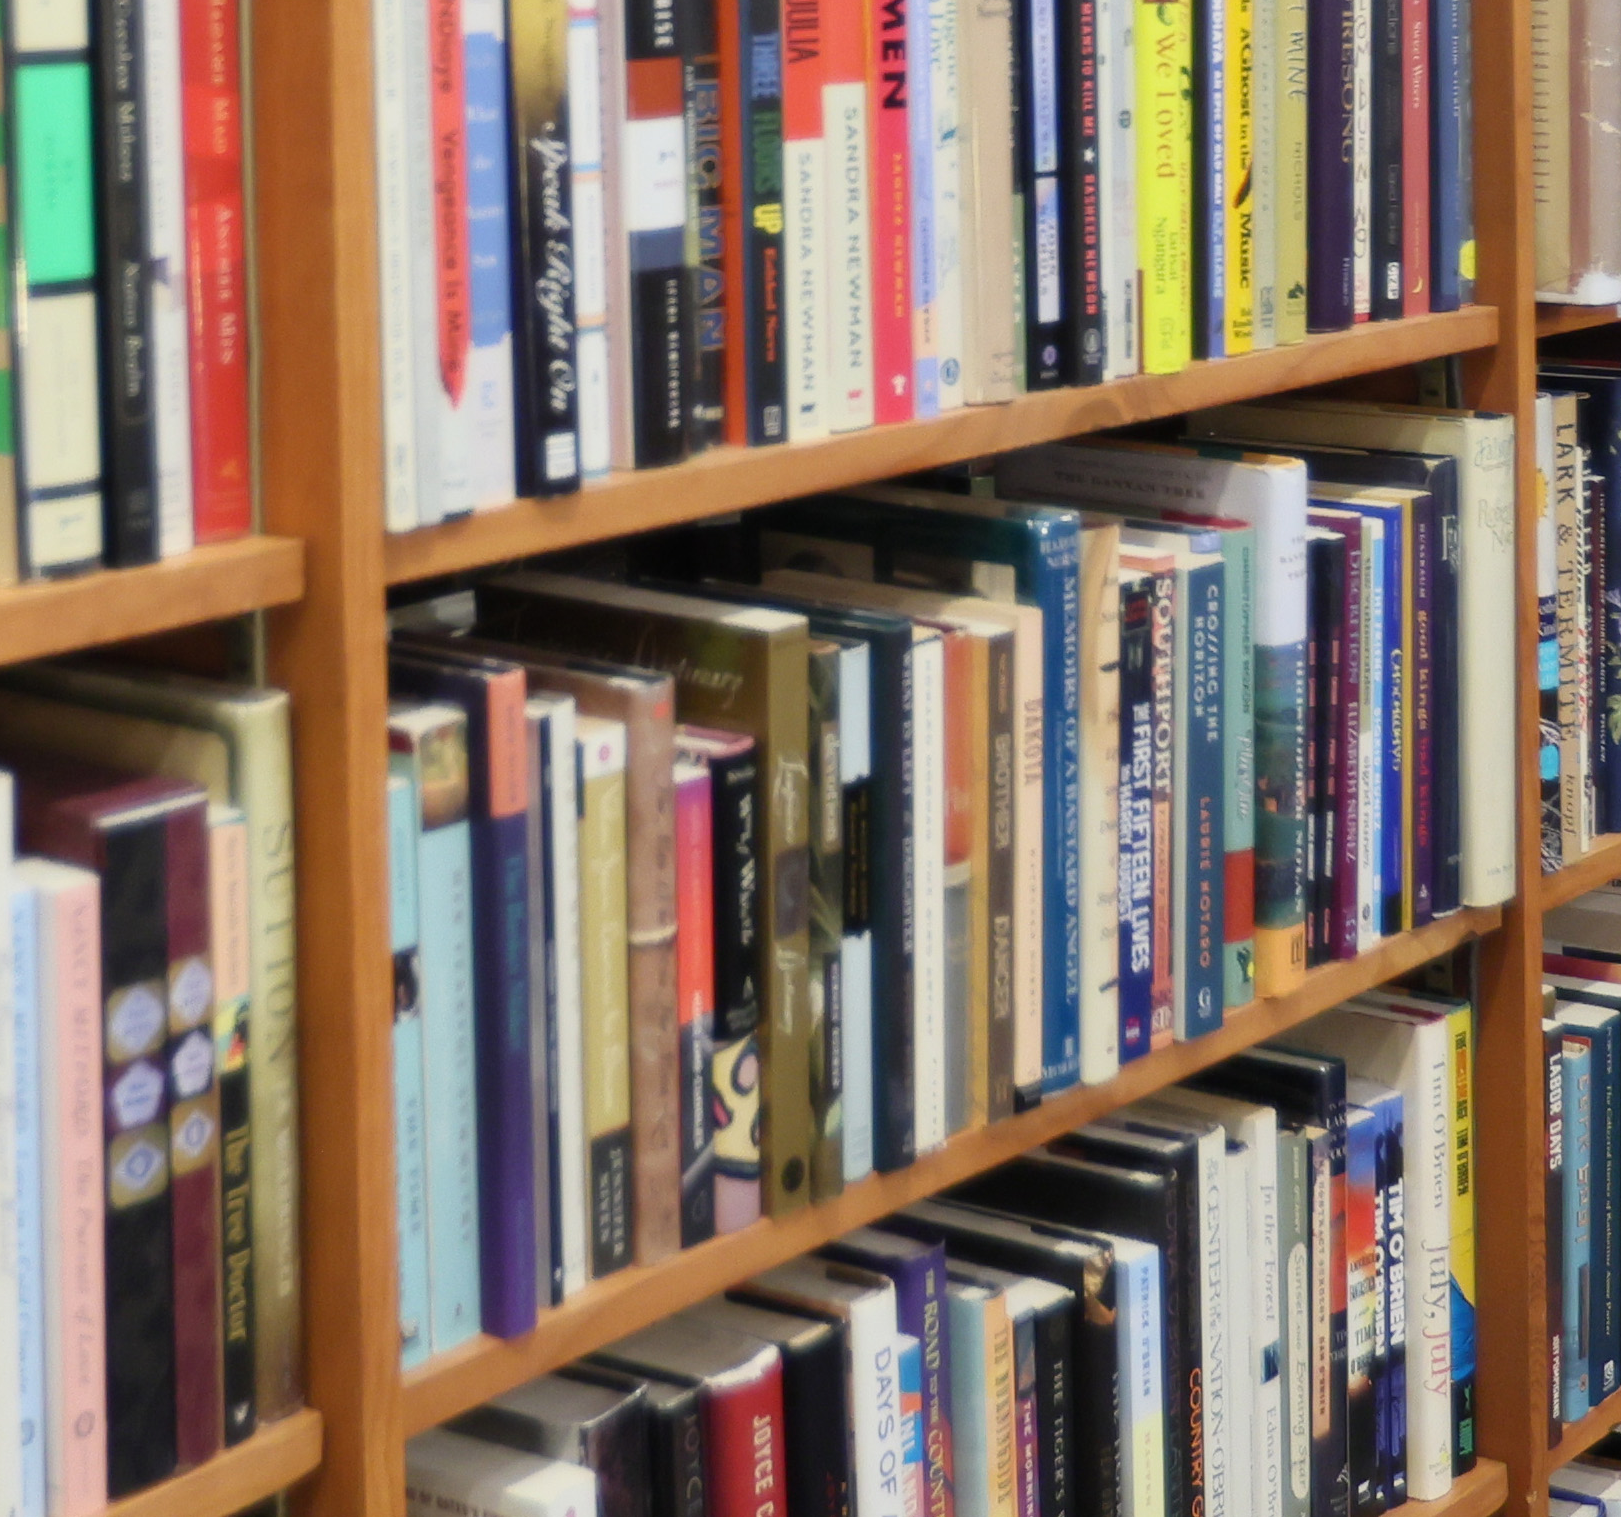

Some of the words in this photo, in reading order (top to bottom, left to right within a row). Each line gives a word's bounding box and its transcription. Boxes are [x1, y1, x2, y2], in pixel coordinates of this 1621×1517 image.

[1080, 3, 1093, 55] MEANS
[1153, 32, 1177, 82] We
[1081, 80, 1094, 111] KILL
[1287, 31, 1306, 105] MINE
[844, 105, 863, 224] SANDRA
[1154, 91, 1181, 180] Loved
[529, 122, 571, 233] Speak
[795, 151, 815, 260] SANDRA
[751, 202, 782, 234] UP
[1238, 211, 1254, 289] Music
[533, 238, 572, 354] Right
[798, 268, 817, 393] NEWMAN
[845, 235, 864, 369] NEWMAN
[549, 358, 573, 413] On
[1554, 423, 1577, 506] LARK
[1345, 549, 1360, 685] DISCRETION
[1414, 609, 1430, 660] good
[1556, 559, 1580, 743] TERMITE
[1153, 578, 1173, 794] SOUTHPORT
[1413, 668, 1430, 730] kings
[1131, 724, 1152, 788] FIRST
[1064, 783, 1079, 905] BASTARD
[1118, 785, 1132, 846] HARRY
[1131, 802, 1152, 900] FIFTEEN
[1416, 784, 1430, 847] kings
[259, 823, 297, 1064] SUTTON
[1130, 907, 1152, 973] LIVES
[1547, 1051, 1563, 1115] LABOR
[1431, 1113, 1447, 1210] O'Brien
[1547, 1118, 1564, 1172] DAYS
[1260, 1185, 1276, 1207] In
[1264, 1214, 1276, 1246] the
[1388, 1177, 1405, 1228] TIM
[1205, 1183, 1222, 1294] CENTER
[225, 1253, 253, 1342] Doctor
[1264, 1250, 1276, 1322] Forest
[1293, 1252, 1307, 1317] Sunset
[1389, 1234, 1405, 1345] O'BRIEN
[1421, 1240, 1451, 1319] July,
[922, 1300, 940, 1371] ROAD
[1421, 1327, 1452, 1399] July
[873, 1347, 897, 1440] DAYS
[1188, 1367, 1202, 1487] COUNTRY
[1293, 1359, 1309, 1436] Evening
[1265, 1407, 1277, 1461] Edna
[1296, 1445, 1309, 1490] Star
[879, 1450, 898, 1496] OF
